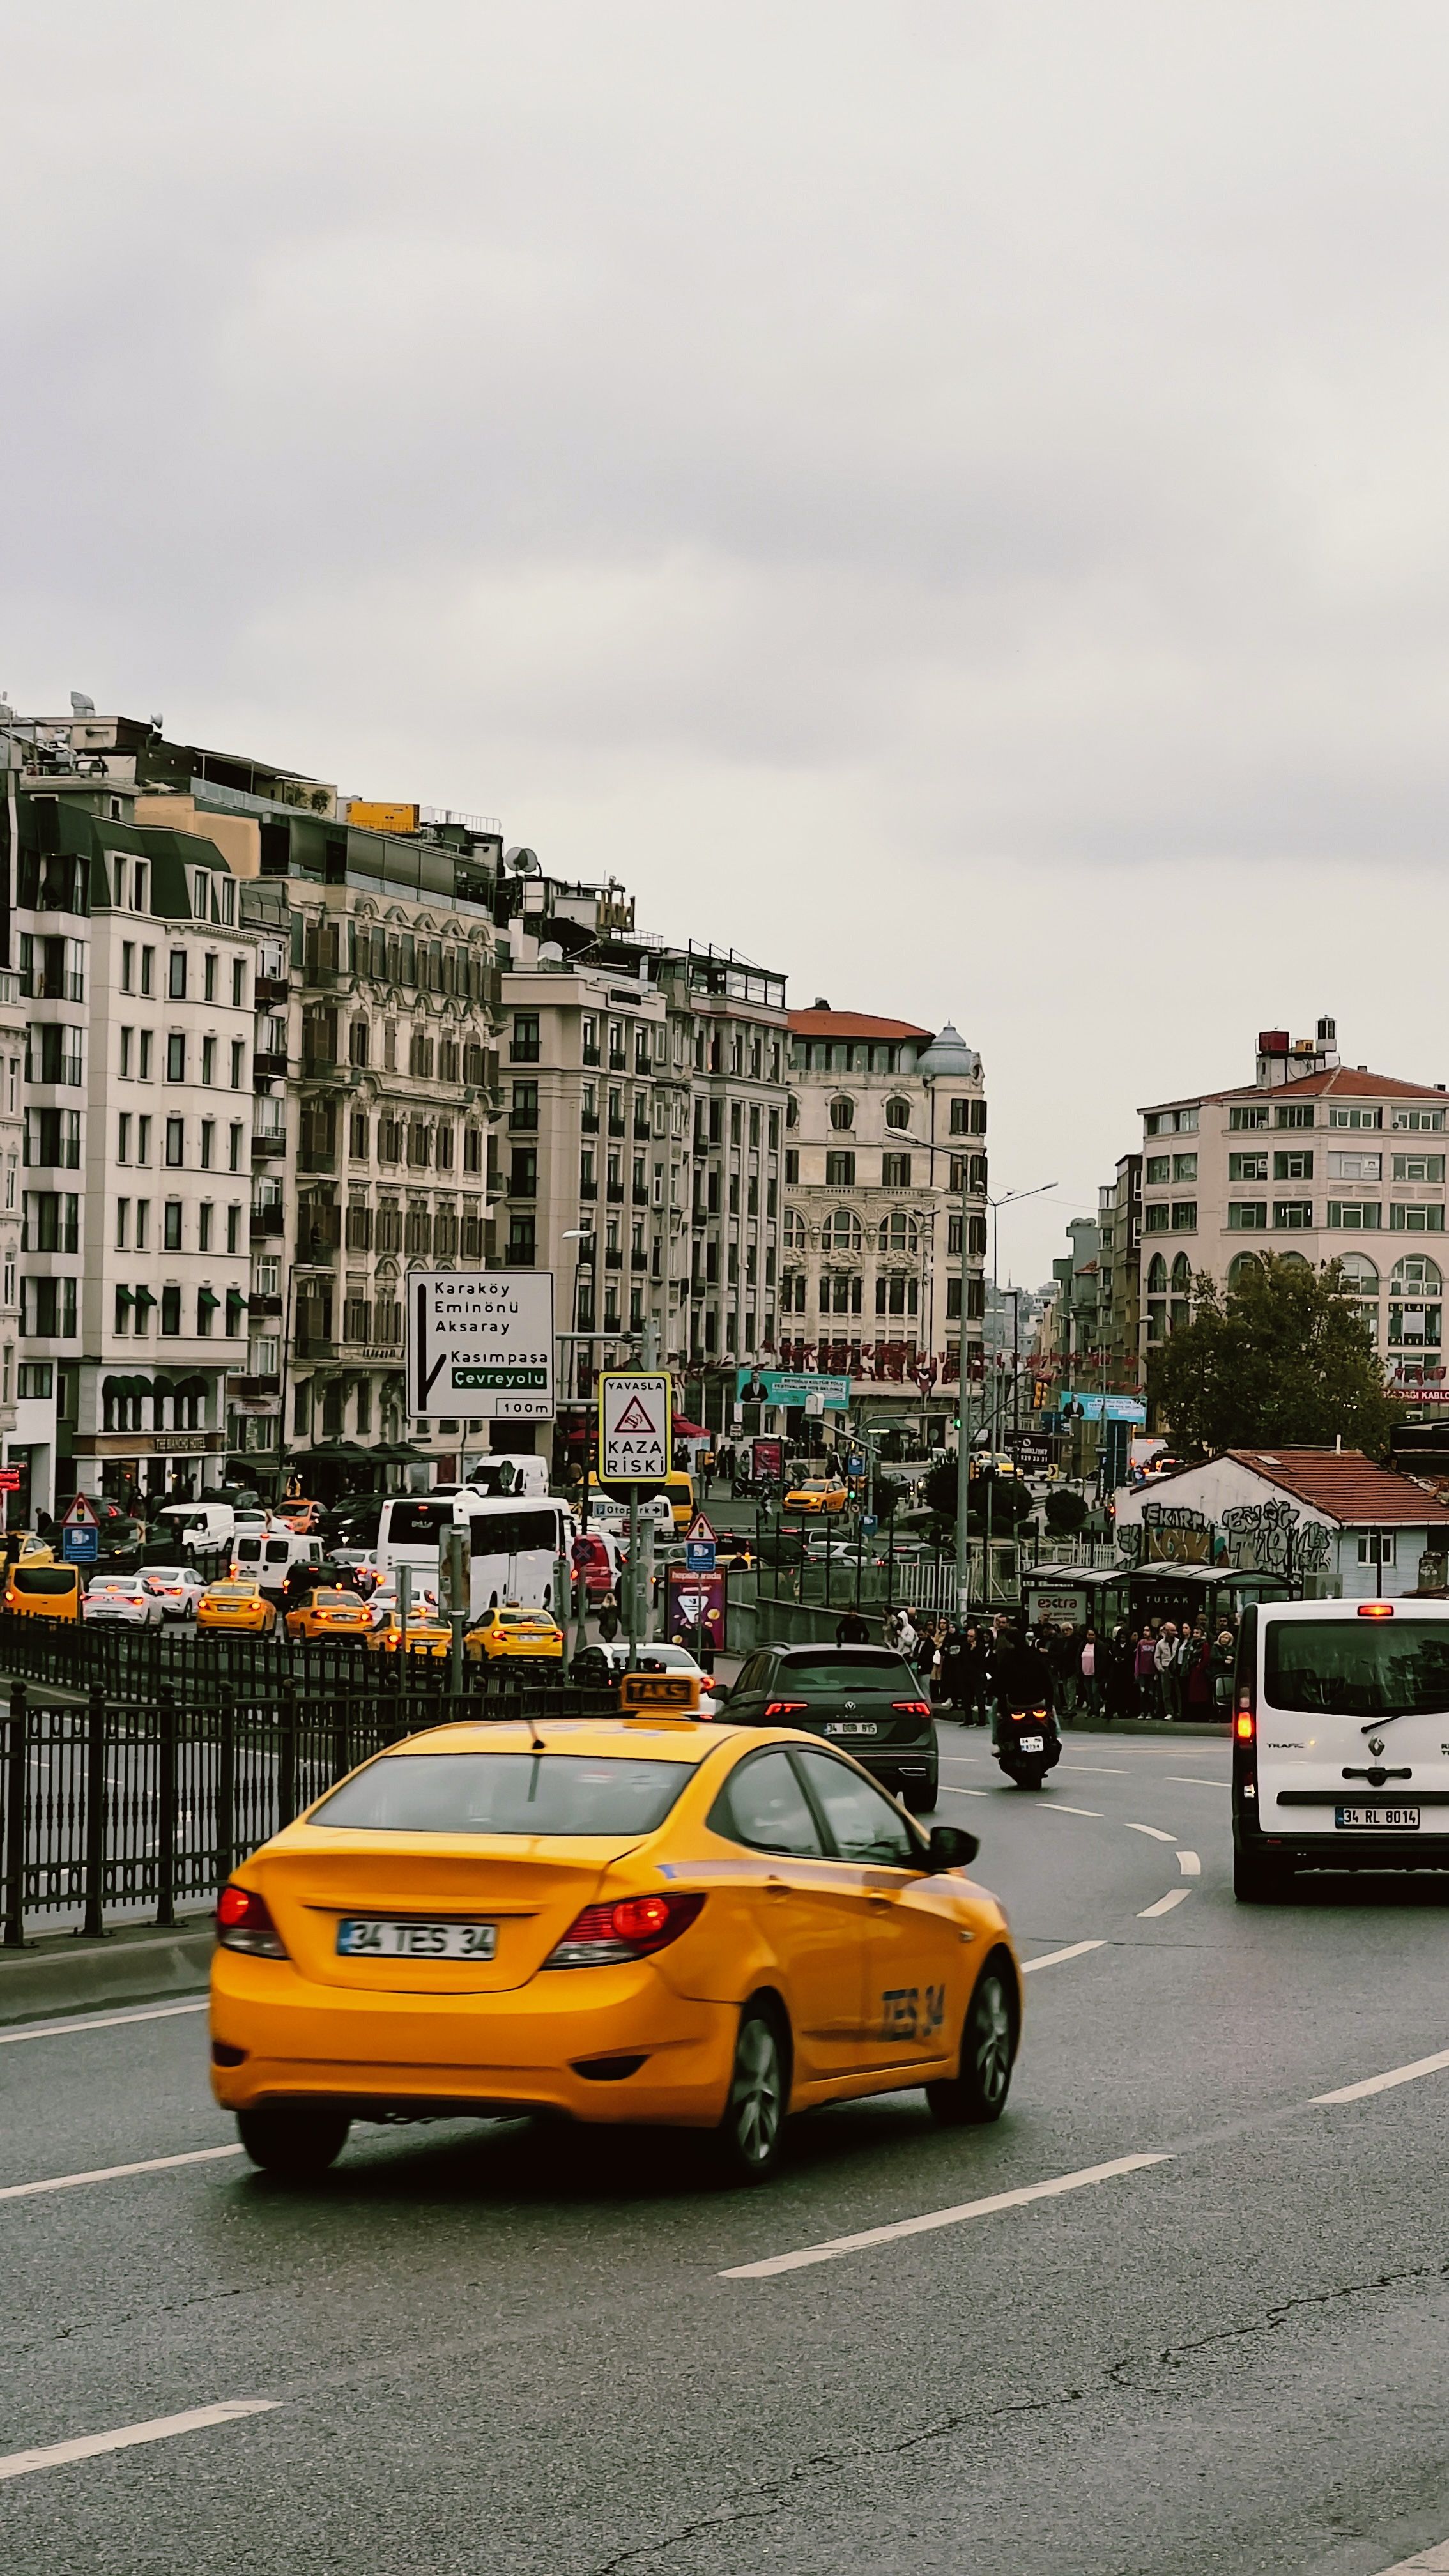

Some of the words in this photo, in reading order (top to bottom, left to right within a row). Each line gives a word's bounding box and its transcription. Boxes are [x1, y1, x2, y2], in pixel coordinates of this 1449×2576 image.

[434, 1282, 509, 1298] Karaköy
[434, 1301, 518, 1313] Eminönü
[435, 1320, 509, 1335] Aksaray
[451, 1351, 548, 1366] Kasımpaşa
[454, 1371, 544, 1387] Çevreyolu
[608, 1382, 663, 1390] YAVAŞLA
[505, 1403, 548, 1413] 100m
[608, 1441, 662, 1454] KAZA
[607, 1456, 664, 1473] RİSKİ
[607, 1506, 650, 1515] Otoprk
[1344, 1809, 1359, 1823] 34
[1365, 1810, 1380, 1823] RL
[1386, 1810, 1416, 1823] 8014
[352, 1924, 382, 1950] 34
[392, 1925, 447, 1954] TES
[461, 1928, 494, 1955] 34
[882, 1988, 919, 2042] TES
[923, 1983, 945, 2037] 34
